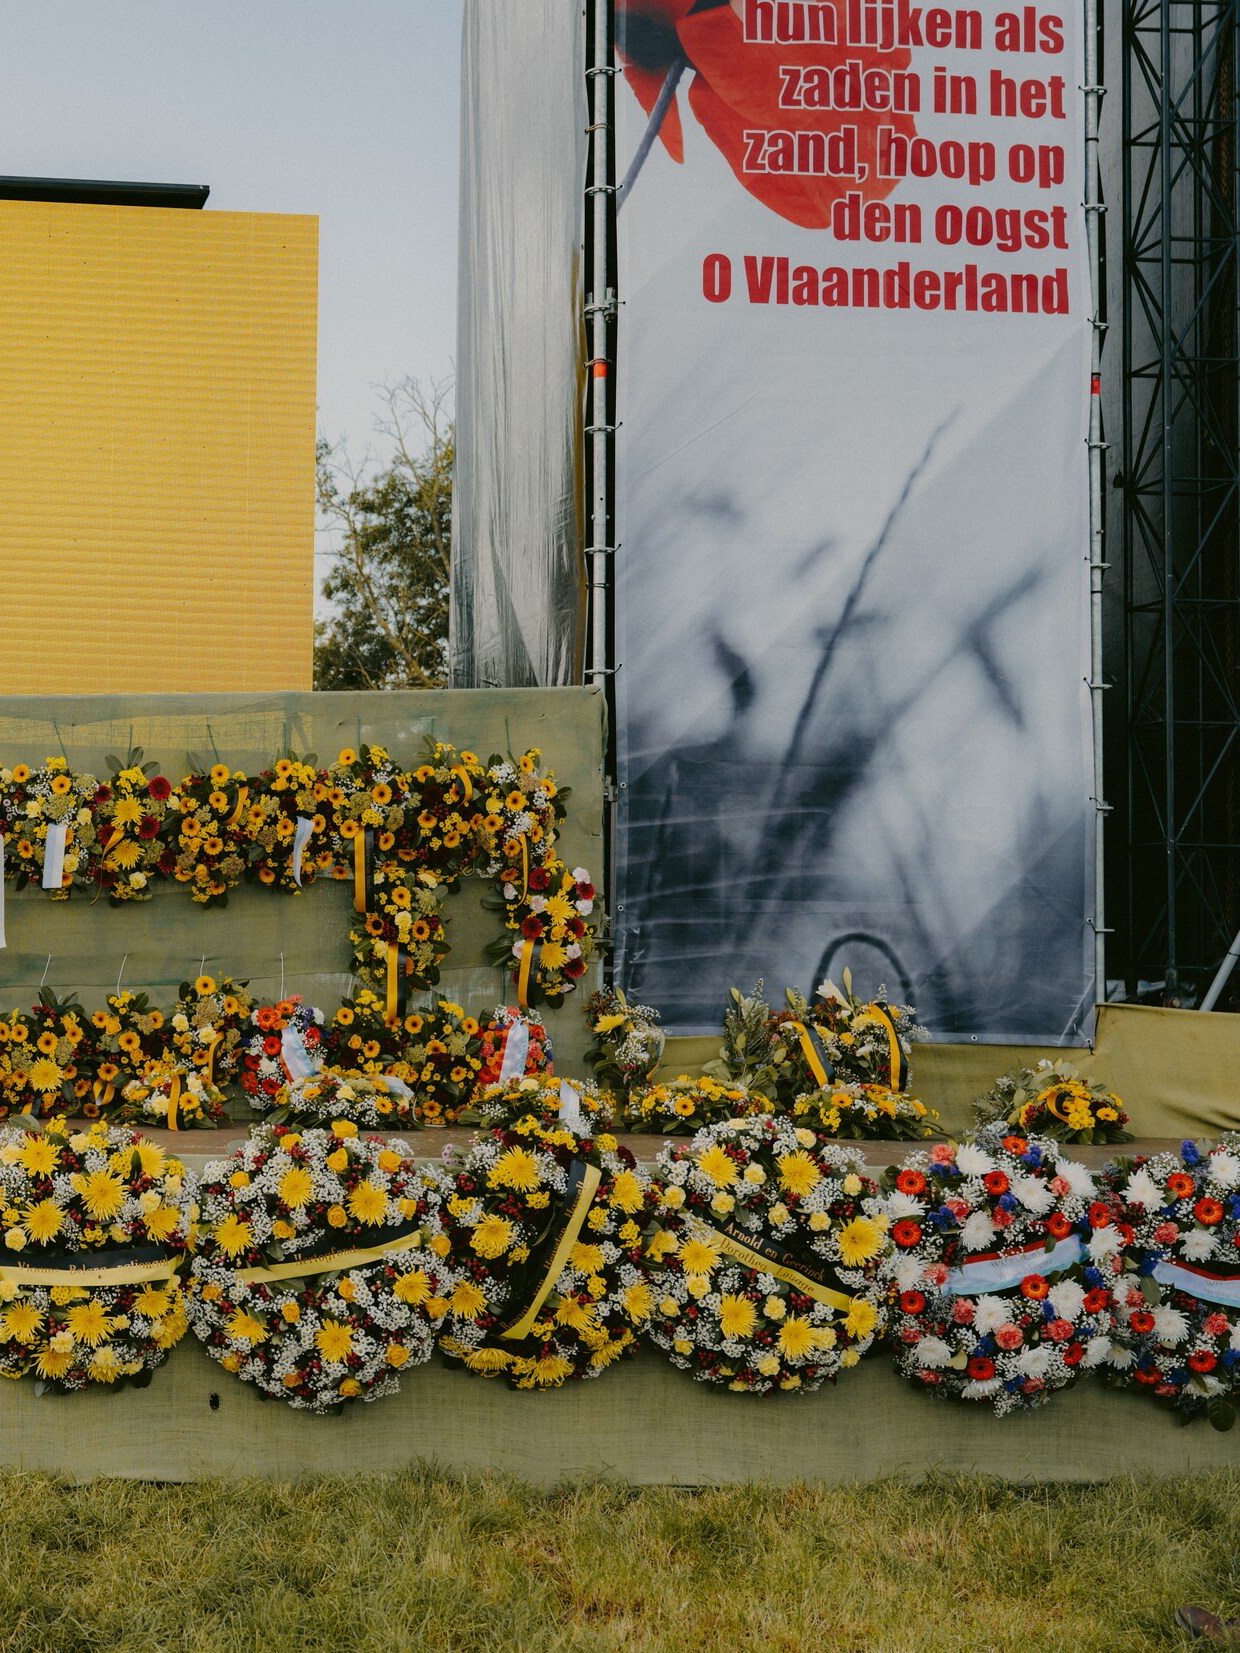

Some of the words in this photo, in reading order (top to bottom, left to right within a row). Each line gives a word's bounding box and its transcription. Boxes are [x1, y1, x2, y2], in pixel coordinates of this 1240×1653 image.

[744, 0, 837, 44] hun
[848, 0, 982, 52] lijken
[995, 6, 1064, 54] als
[780, 60, 921, 113] zaden
[934, 66, 978, 115] in
[990, 69, 1066, 119] het
[744, 125, 868, 182] zand,
[878, 126, 995, 186] hoop
[1008, 139, 1065, 189] op
[832, 192, 922, 244] den
[935, 202, 1069, 253] oogst
[702, 253, 732, 304] O
[744, 255, 1070, 315] Vlaanderland
[543, 1226, 567, 1271] Heusden
[563, 1180, 585, 1219] Hasselt
[724, 1222, 764, 1250] Arnold
[764, 1245, 778, 1259] en
[781, 1252, 825, 1281] Geerinck
[293, 1244, 362, 1267] Hertogfonds
[720, 1236, 768, 1271] Dorothea
[775, 1265, 815, 1293] Louage
